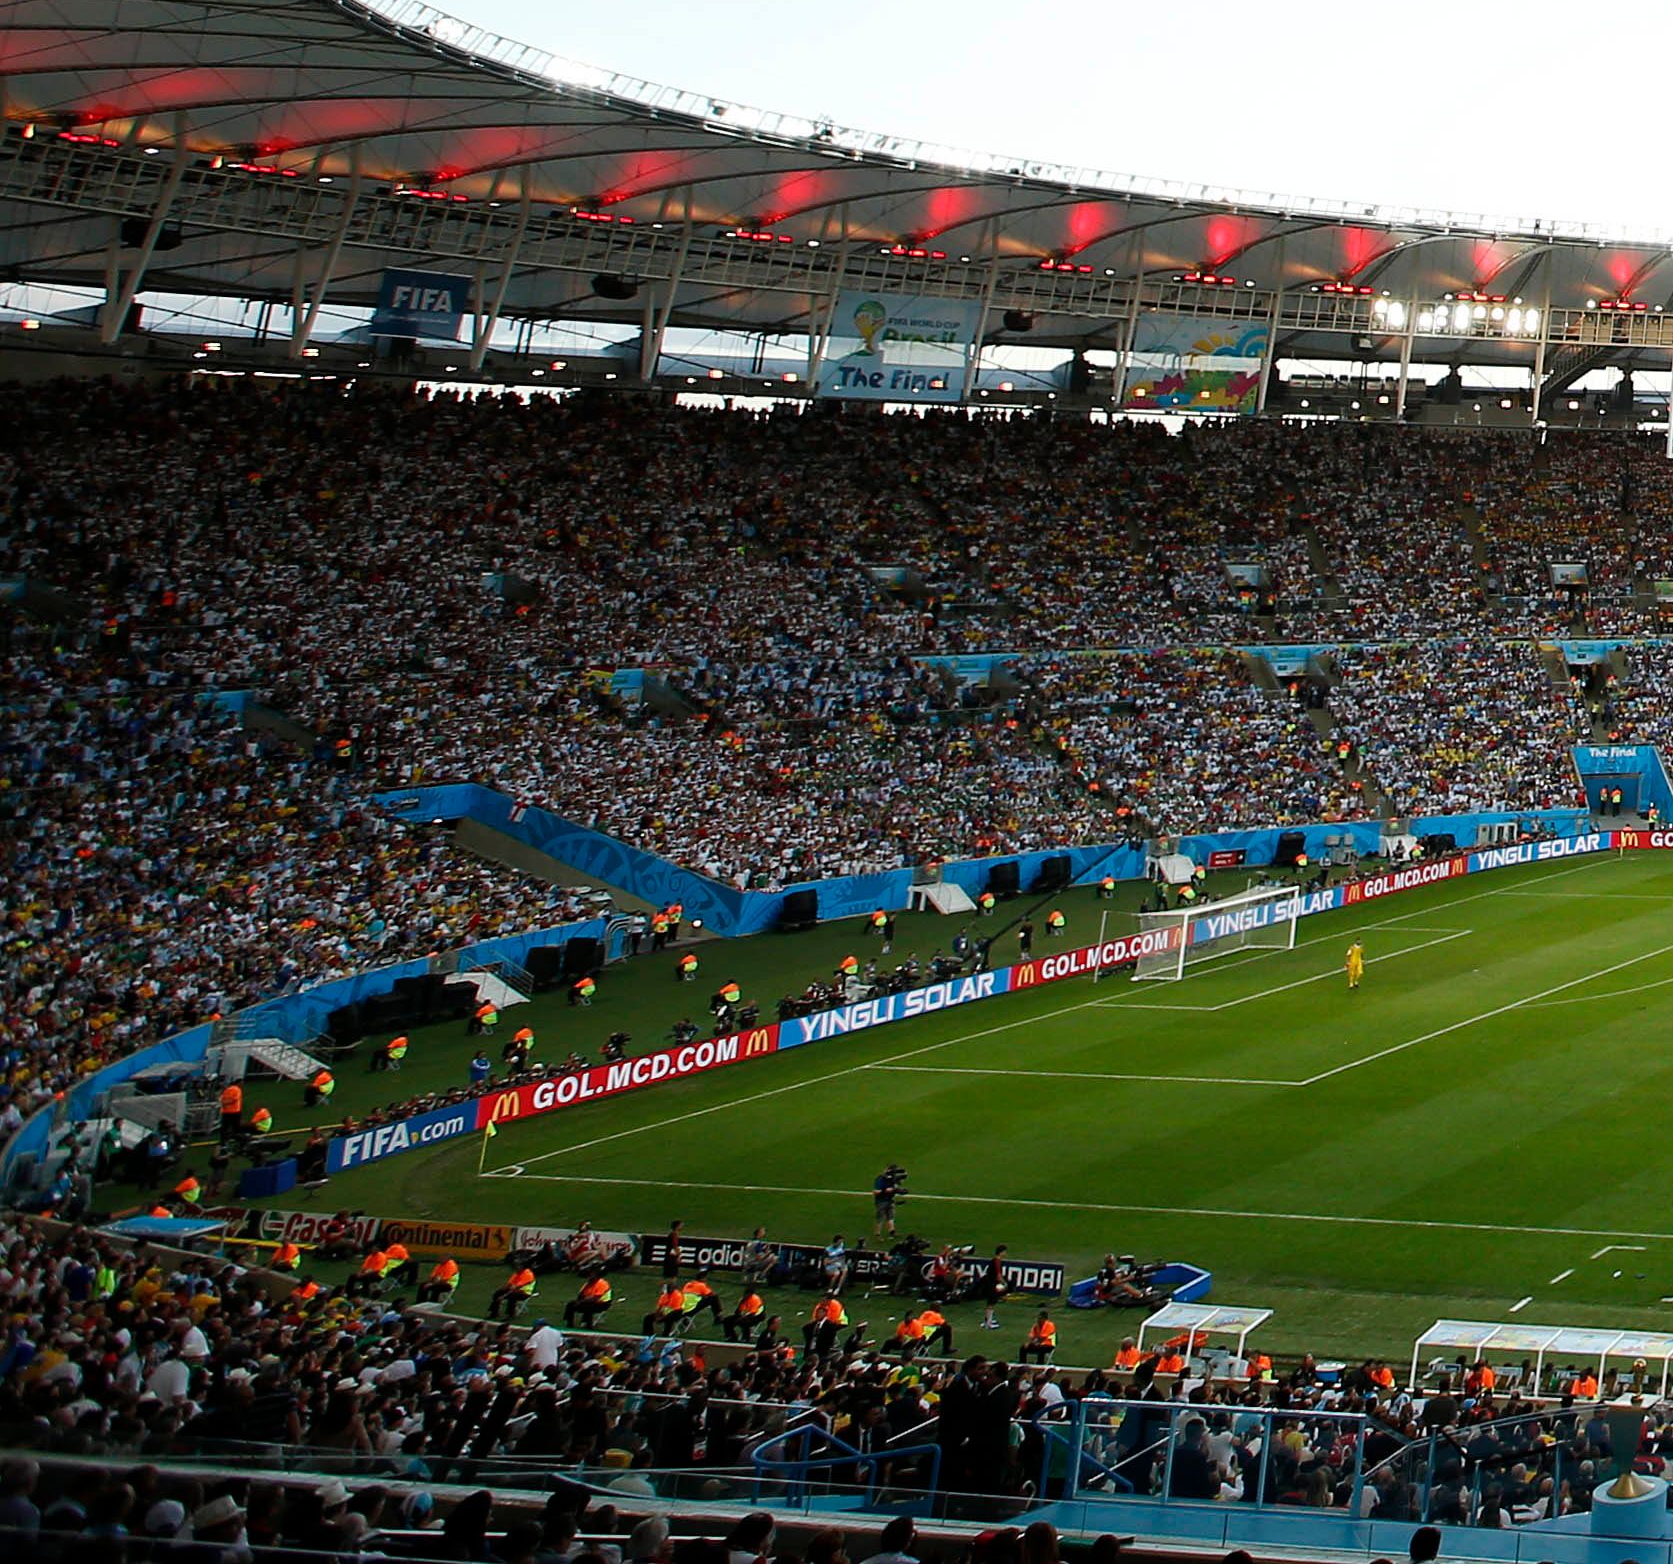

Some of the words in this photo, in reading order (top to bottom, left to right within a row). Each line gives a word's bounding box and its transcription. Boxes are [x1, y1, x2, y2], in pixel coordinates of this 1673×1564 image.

[391, 285, 452, 312] FIFA
[839, 366, 884, 388] The
[890, 369, 949, 391] Final
[1478, 844, 1533, 869] YINGLI
[1537, 833, 1600, 860] SOLAR
[1364, 860, 1450, 899] GOL.MCD.COM
[1207, 902, 1270, 937] YINGLI
[1274, 889, 1335, 922] SOLAR
[1041, 929, 1169, 980] GOL.MCD.COM
[801, 996, 895, 1040] YINGLI
[903, 972, 995, 1012] SOLAR
[532, 1036, 738, 1111] GOL.MCD.COM
[284, 1212, 376, 1248] Casol
[697, 1244, 745, 1267] adid
[960, 1264, 1063, 1290] HYNDAI
